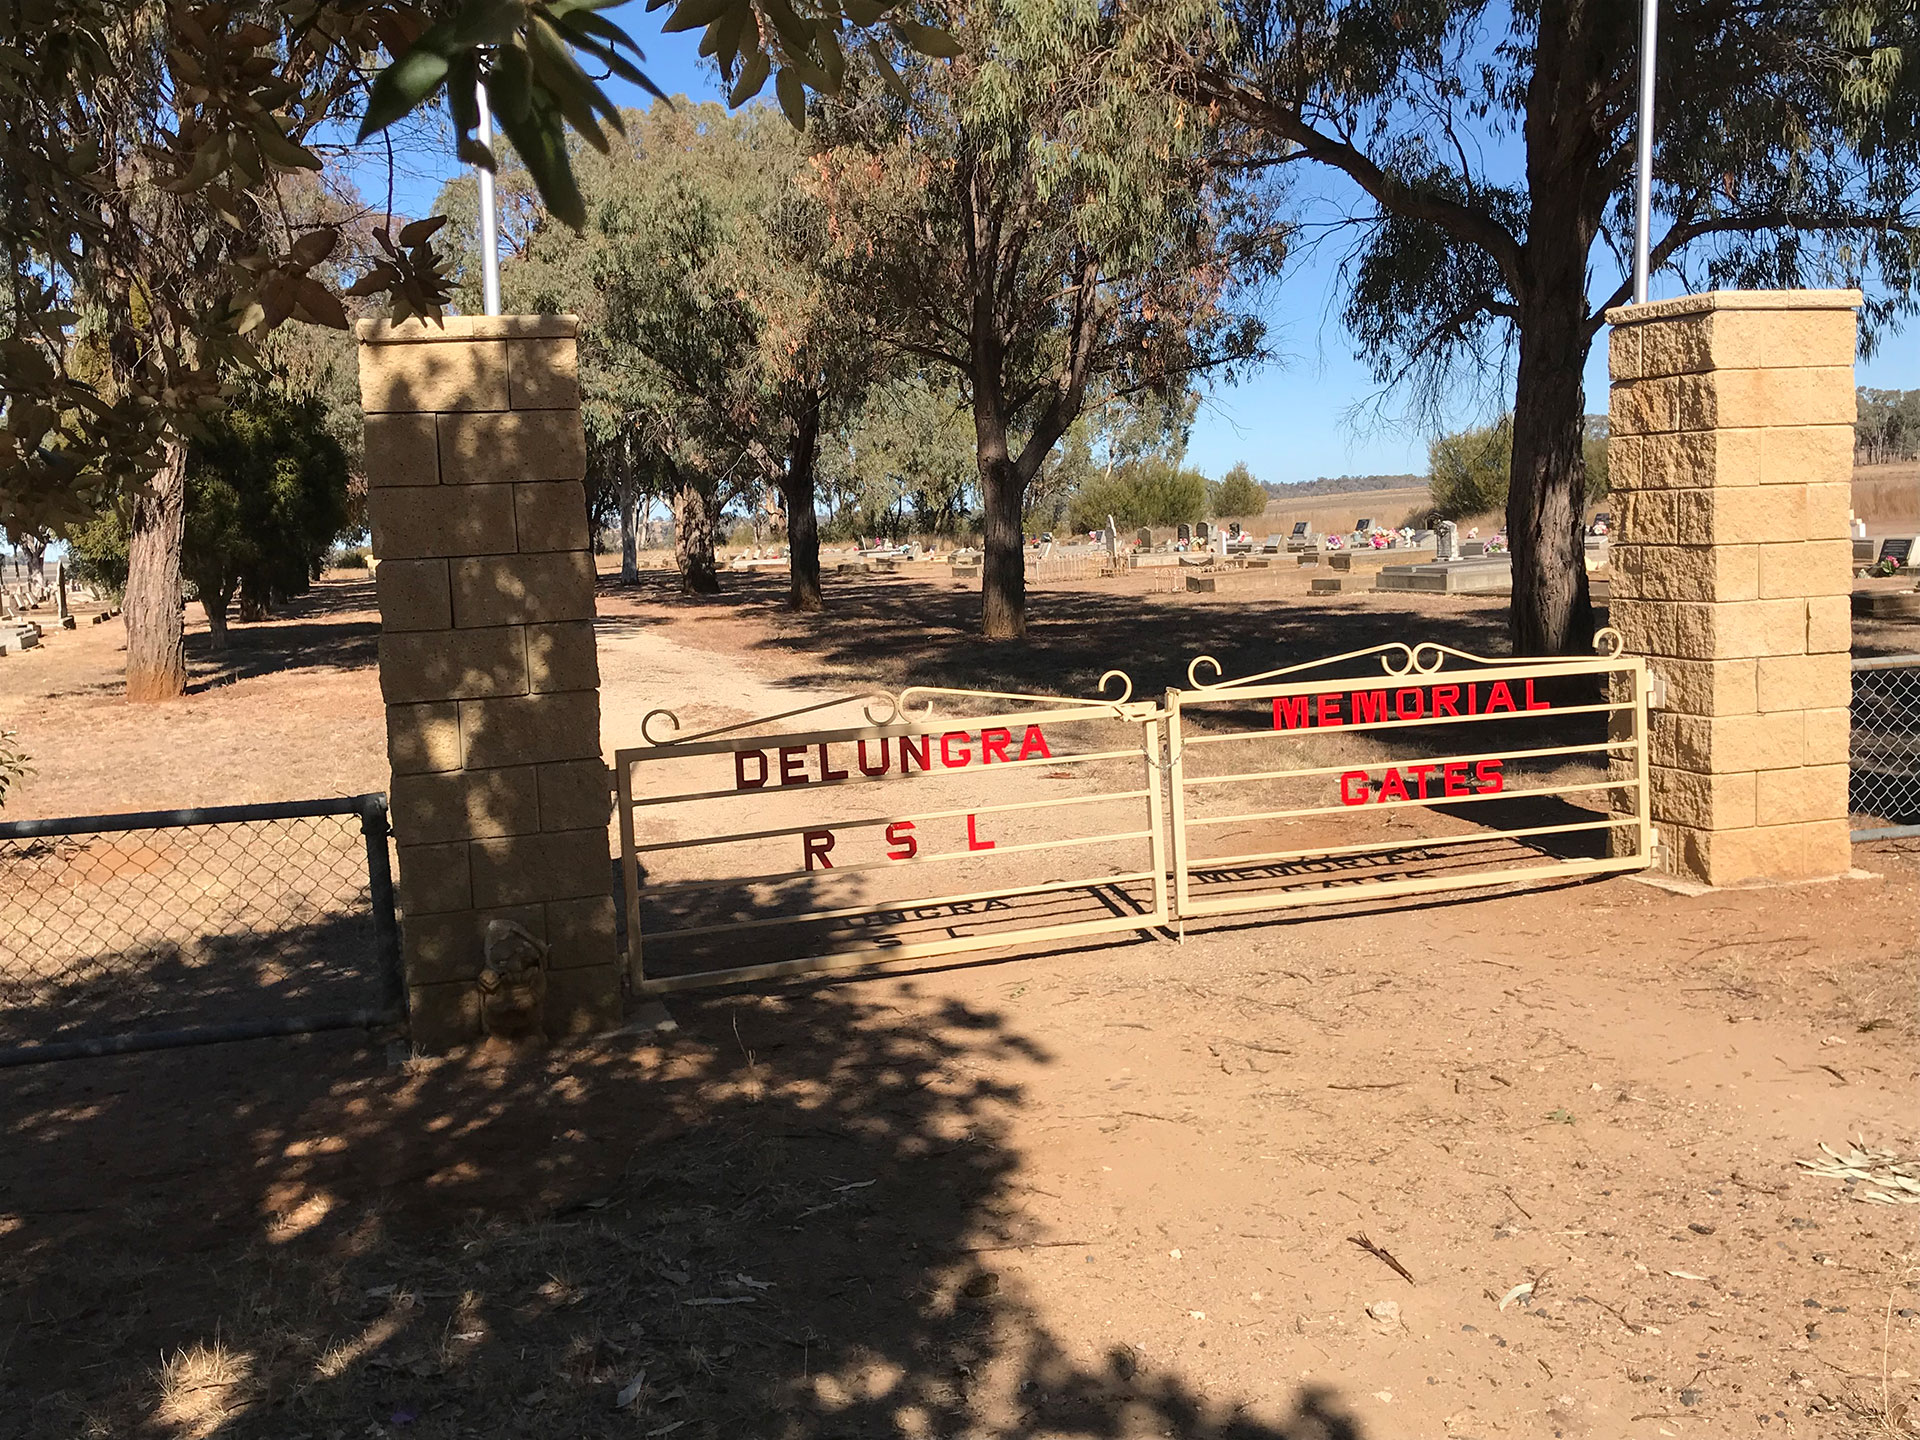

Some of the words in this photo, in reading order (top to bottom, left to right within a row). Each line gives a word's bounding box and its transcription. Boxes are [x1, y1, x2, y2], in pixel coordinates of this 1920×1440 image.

[1272, 678, 1551, 731] MEMORIAL
[736, 724, 1052, 790] DELUNGRA
[1341, 759, 1505, 806] GATES
